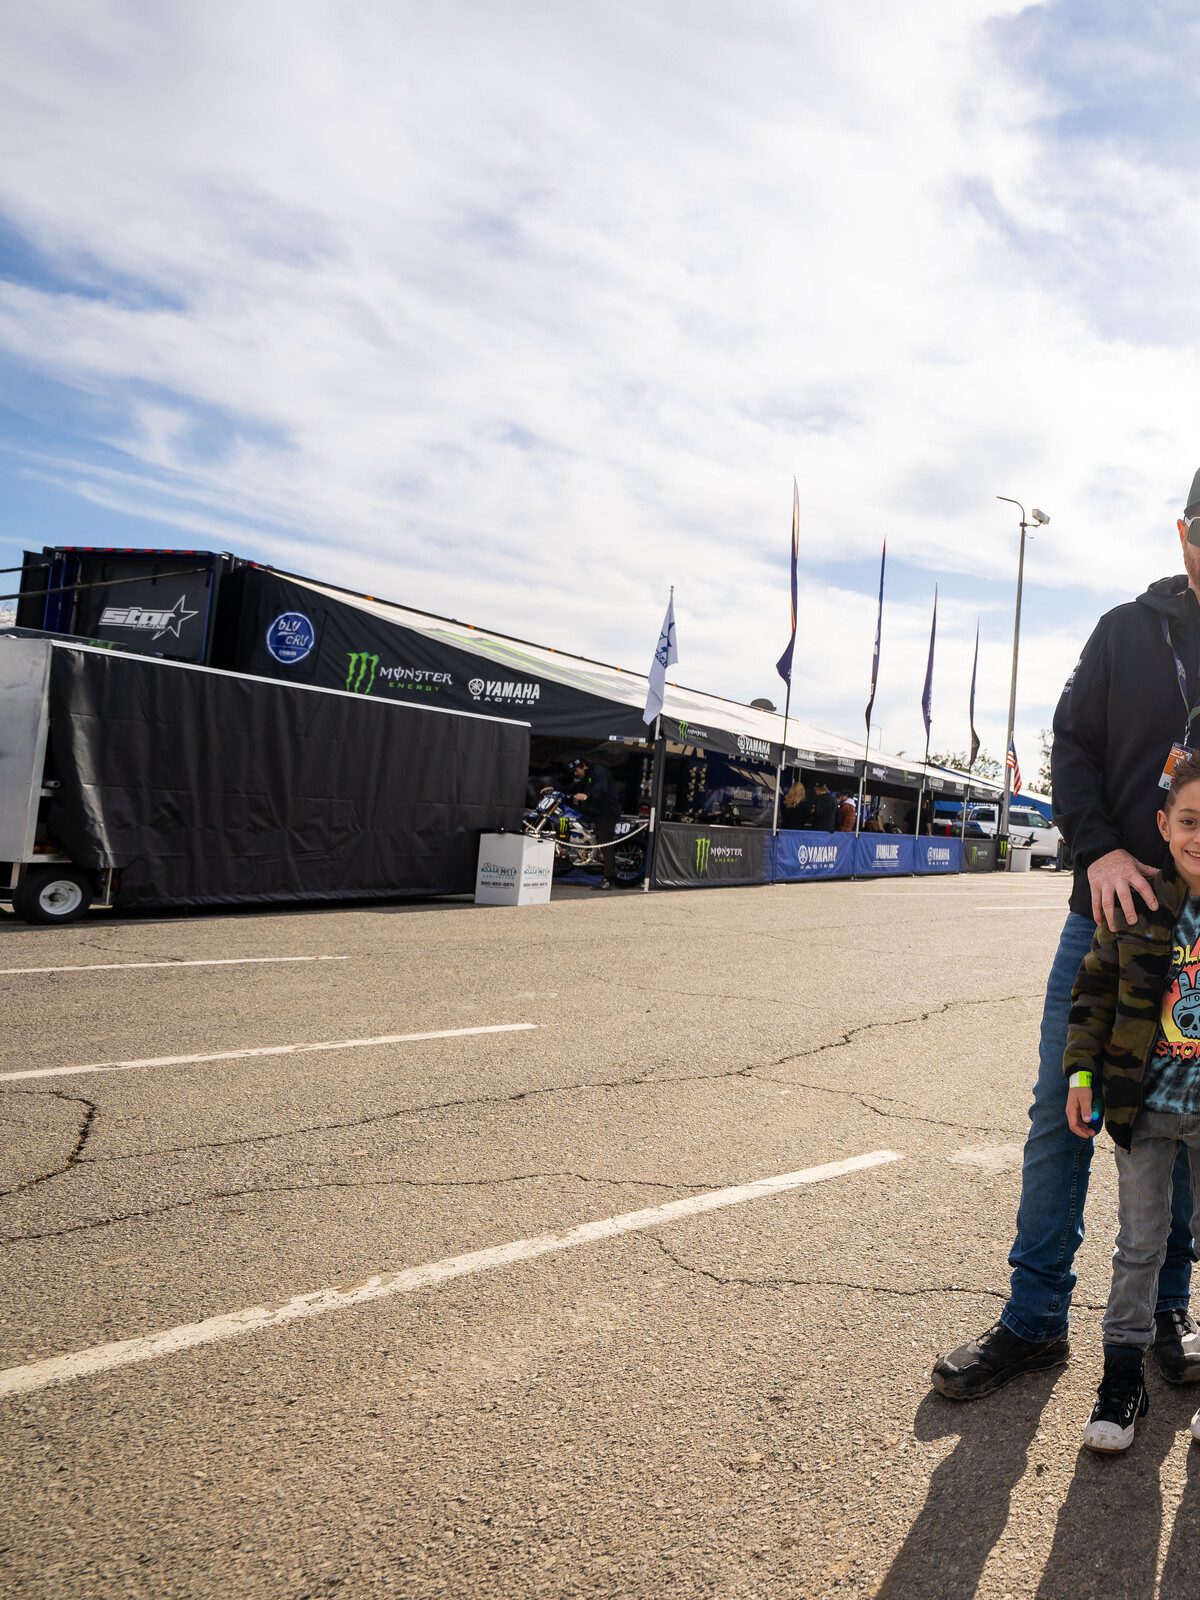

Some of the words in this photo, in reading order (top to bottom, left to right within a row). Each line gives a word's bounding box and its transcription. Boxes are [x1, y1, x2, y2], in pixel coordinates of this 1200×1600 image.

[101, 609, 176, 625] star
[389, 682, 440, 692] ENERGY
[485, 680, 541, 699] YAMAHA
[473, 696, 535, 705] RACING
[745, 737, 770, 754] YAMAHA
[741, 749, 769, 759] RACING
[808, 846, 838, 863] YAMAHA
[932, 848, 950, 861] YAMAHA
